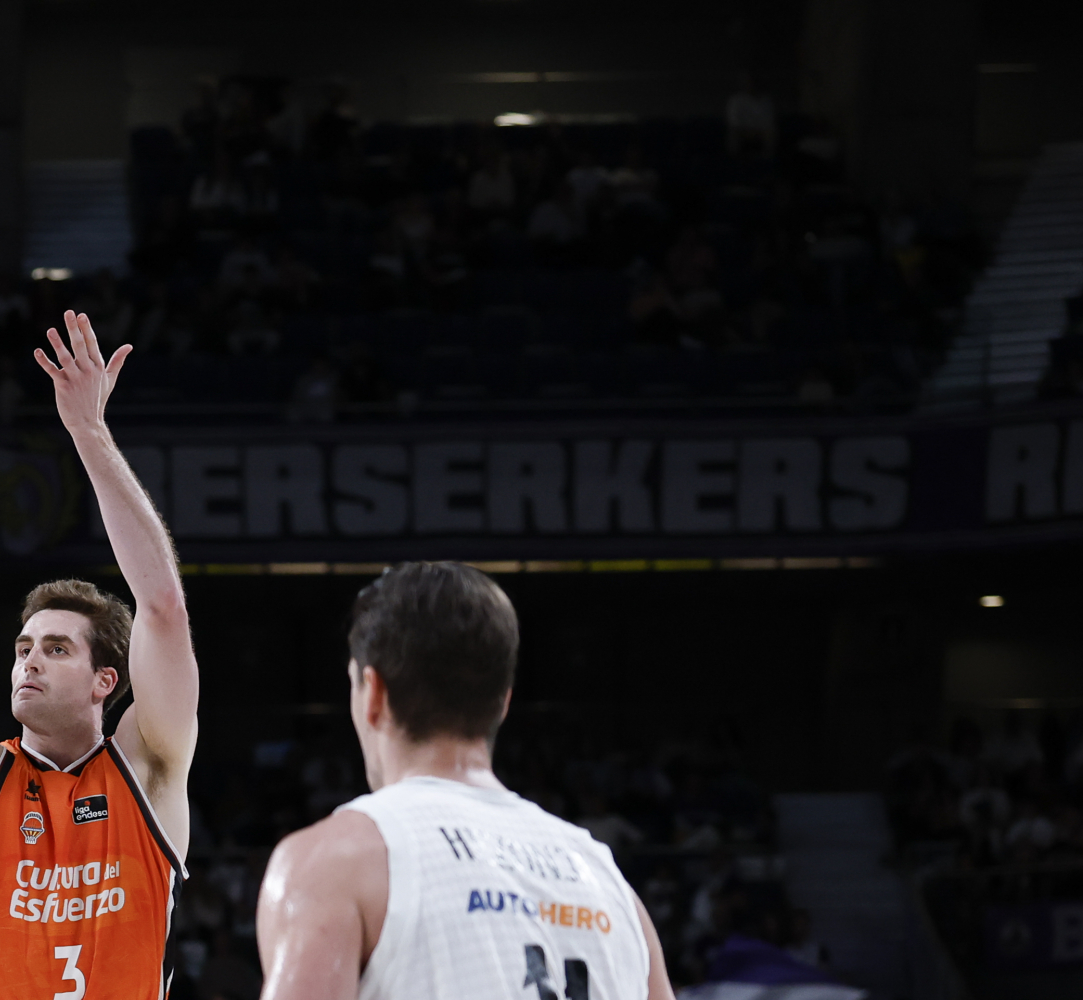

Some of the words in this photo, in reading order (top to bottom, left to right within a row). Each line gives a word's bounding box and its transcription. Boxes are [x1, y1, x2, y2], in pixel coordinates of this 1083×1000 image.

[74, 805, 90, 815] liga
[76, 810, 108, 821] endesa
[16, 859, 101, 891] Cultura
[104, 861, 120, 881] del
[9, 887, 125, 923] Esfuerzo
[467, 889, 611, 934] AUTOHERO
